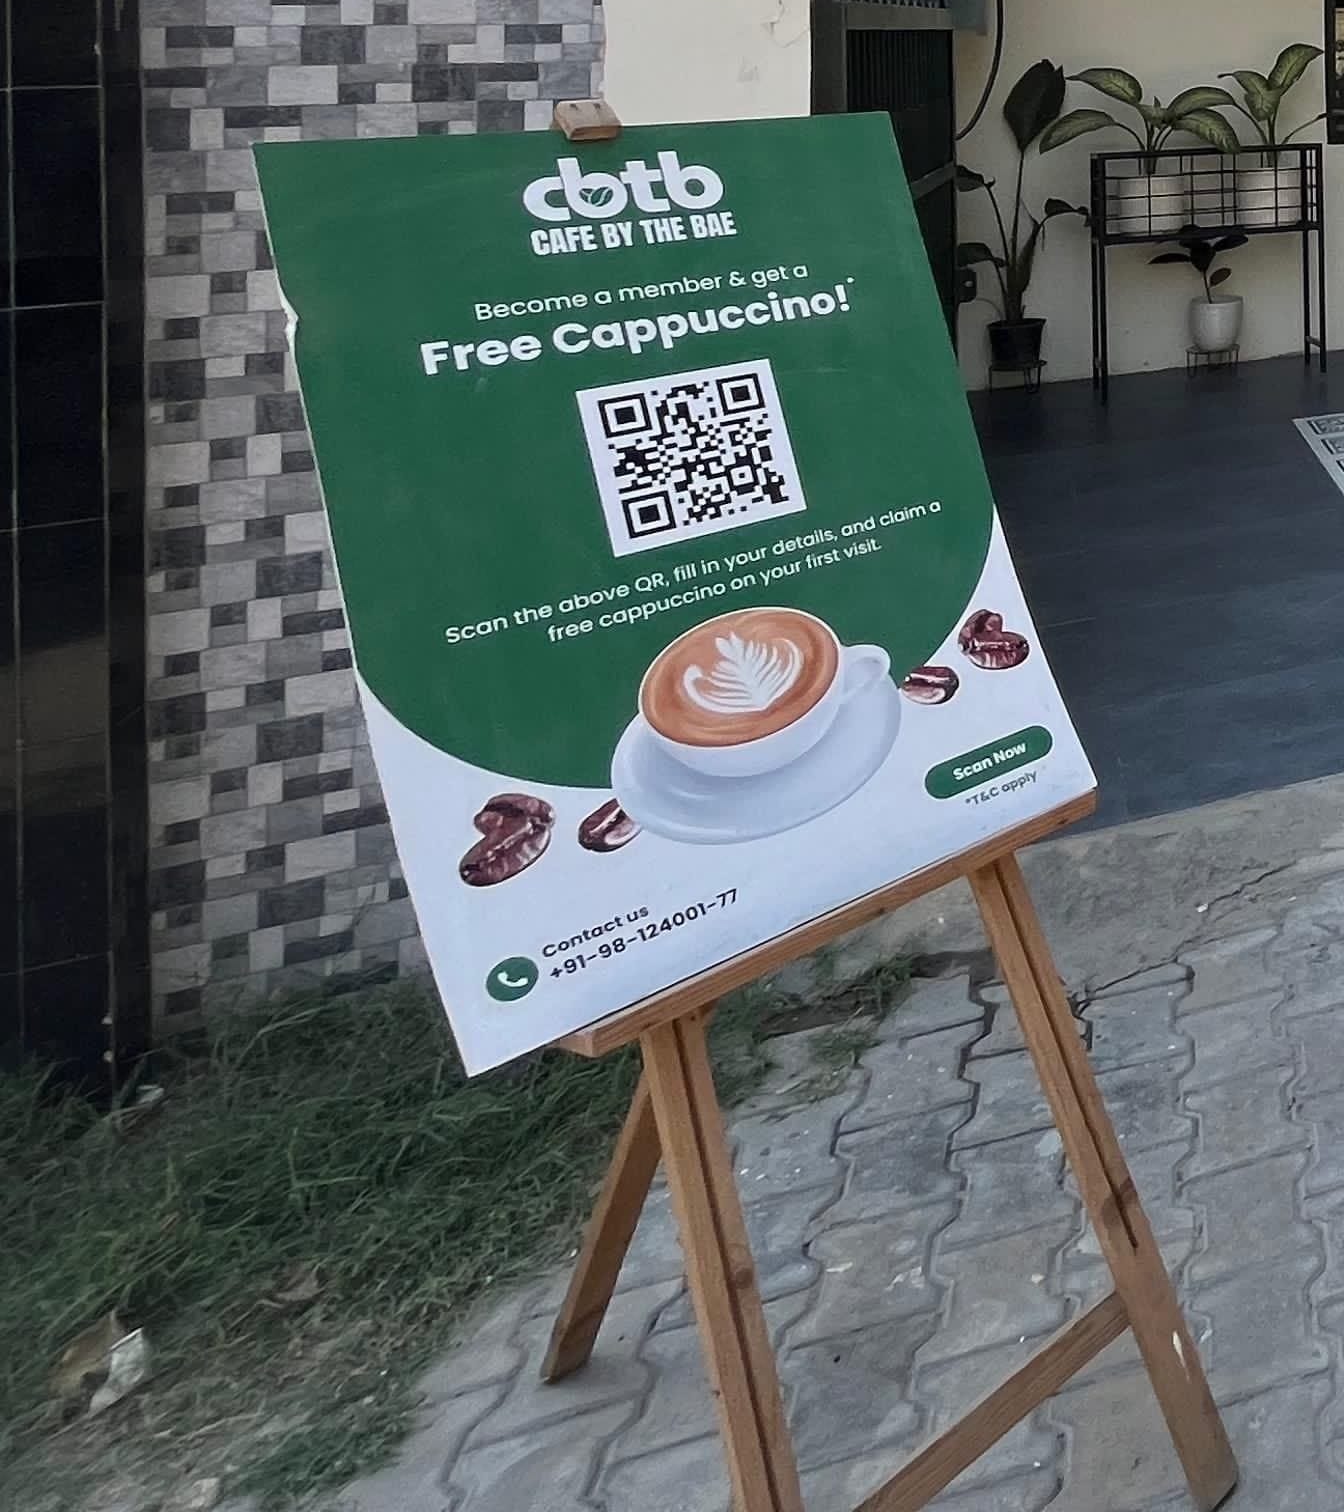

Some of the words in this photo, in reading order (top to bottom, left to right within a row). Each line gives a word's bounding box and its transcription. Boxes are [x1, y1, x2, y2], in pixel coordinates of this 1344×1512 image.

[523, 150, 724, 222] cbtb
[530, 224, 598, 256] CAFE
[601, 220, 634, 249] BY
[639, 216, 688, 244] THE
[689, 211, 738, 239] BAE
[474, 294, 588, 321] Become
[594, 289, 613, 306] a
[618, 273, 723, 303] member
[728, 270, 747, 288] &
[751, 264, 790, 288] get
[793, 263, 809, 279] a
[420, 334, 543, 376] Free
[445, 615, 509, 644] Scan
[513, 604, 554, 626] the
[557, 583, 630, 615] above
[634, 571, 671, 594] QR,
[673, 562, 698, 584] fill
[701, 558, 721, 576] in
[724, 545, 768, 573] your
[771, 527, 839, 557] details,
[840, 515, 877, 538] and
[879, 505, 927, 528] claim
[930, 499, 942, 514] a
[547, 617, 595, 643] free
[598, 581, 727, 630] cappuccino
[729, 573, 757, 591] on
[759, 560, 802, 587] your
[804, 548, 842, 571] first
[842, 538, 883, 559] visit.
[952, 757, 993, 780] Scan
[992, 743, 1027, 764] Now
[1001, 771, 1037, 792] apply
[542, 916, 623, 957] Contact
[626, 905, 650, 923] us
[550, 888, 738, 978] +91-98-124001-77
